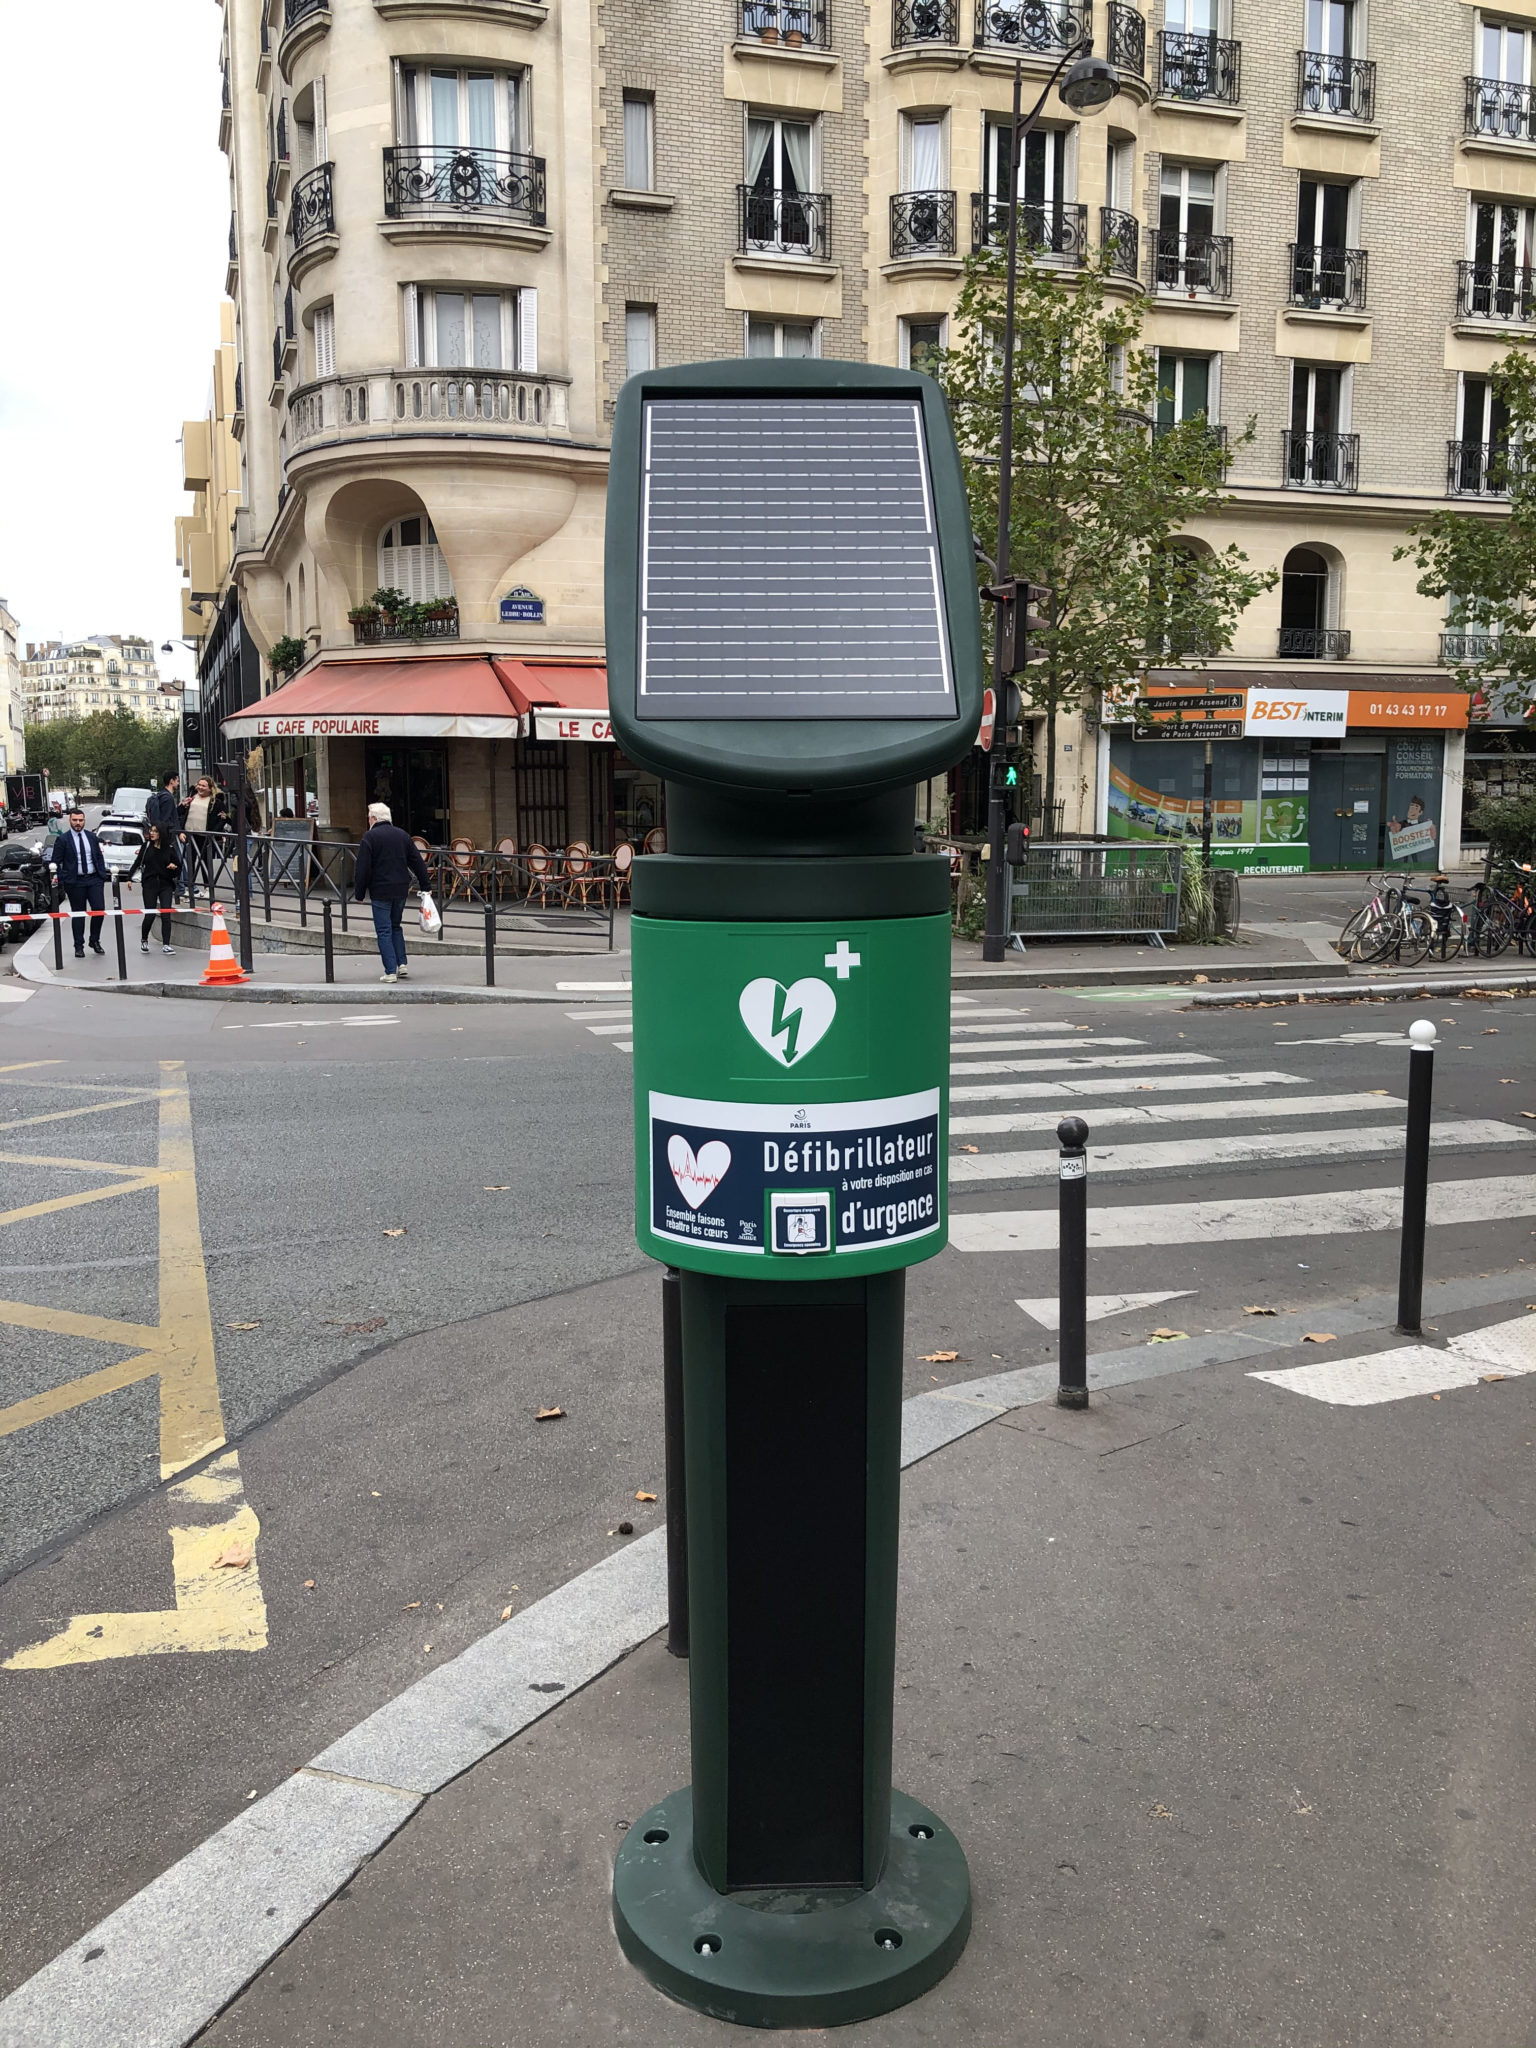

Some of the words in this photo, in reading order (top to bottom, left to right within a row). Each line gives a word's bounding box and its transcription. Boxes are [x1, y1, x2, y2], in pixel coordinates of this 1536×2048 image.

[1251, 701, 1307, 720] BEST
[1369, 704, 1382, 715] 01
[1386, 704, 1399, 716] 43
[1402, 704, 1415, 716] 43
[1418, 705, 1431, 716] 17
[1434, 705, 1447, 717] 17
[257, 721, 270, 735] LE
[276, 720, 306, 734] CAFE
[312, 719, 380, 734] POPULAIRE
[559, 721, 580, 738] LE
[1396, 751, 1434, 760] CONSEIL
[1392, 829, 1431, 846] BOOSTEZ
[1215, 849, 1235, 857] depuis
[1243, 866, 1304, 874] RECRUTEMENT
[763, 1132, 933, 1173] Défibrillateur
[842, 1178, 848, 1191] à
[850, 1177, 873, 1190] votre
[875, 1169, 914, 1188] disposition
[915, 1167, 923, 1178] en
[923, 1164, 933, 1176] cas
[665, 1205, 696, 1222] Ensemble
[697, 1212, 725, 1227] faisons
[842, 1193, 933, 1235] d'urgence
[666, 1218, 690, 1233] rebattre
[691, 1222, 702, 1235] les
[739, 1219, 758, 1228] Paris
